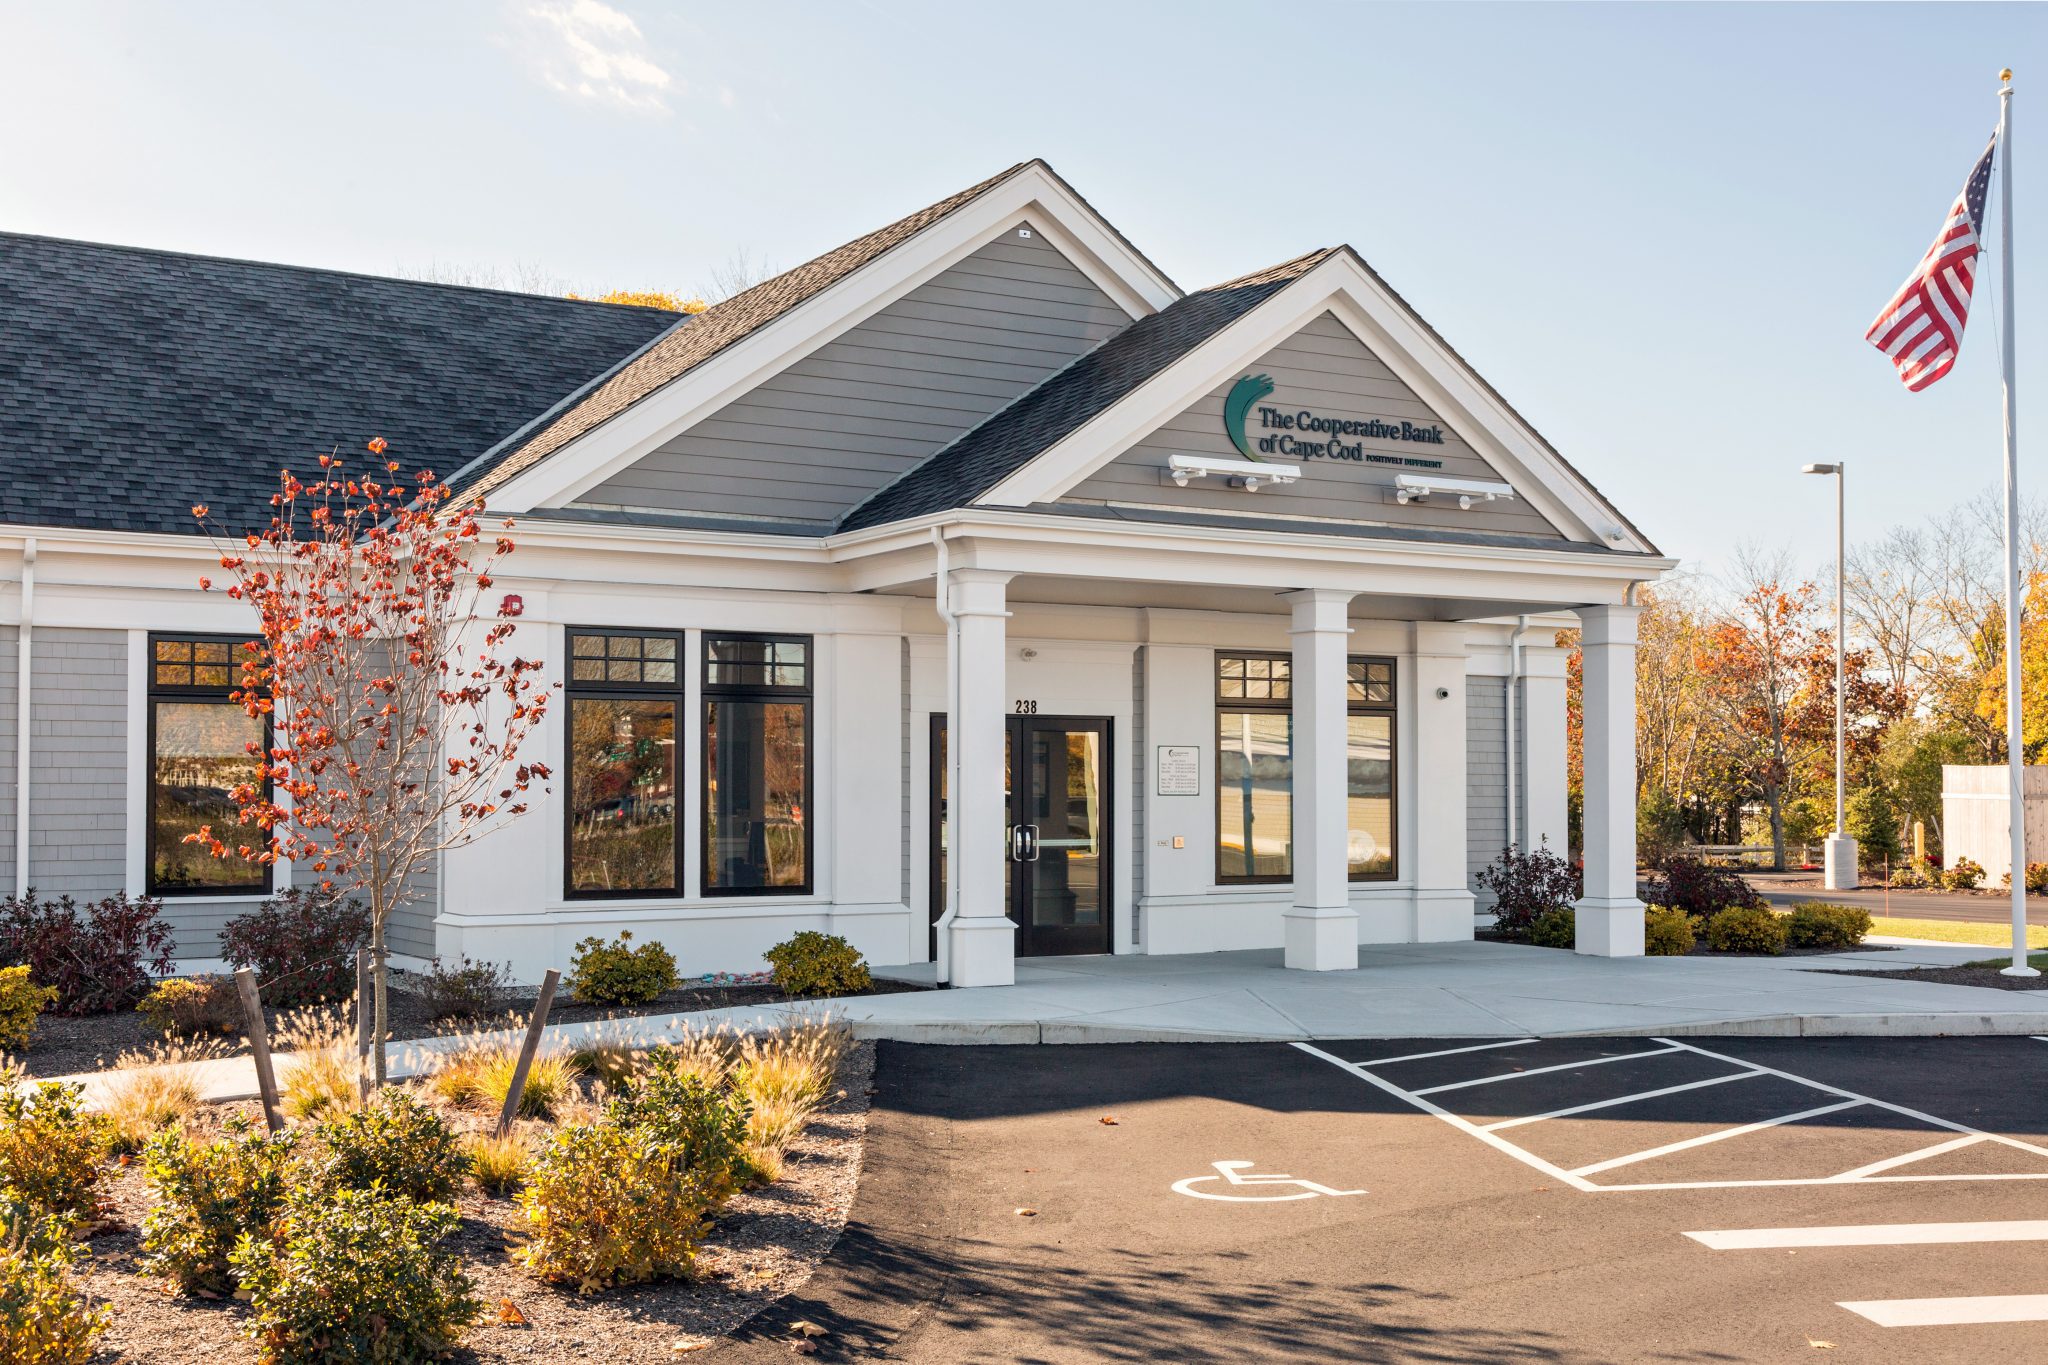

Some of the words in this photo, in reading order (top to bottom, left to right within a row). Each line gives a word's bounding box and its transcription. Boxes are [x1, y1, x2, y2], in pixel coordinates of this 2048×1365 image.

[1259, 407, 1294, 429] The
[1297, 411, 1400, 440] Cooperative
[1401, 421, 1445, 444] Bank
[1259, 433, 1278, 453] of
[1279, 435, 1325, 461] Cape
[1327, 439, 1363, 461] Cod
[1366, 454, 1403, 465] POSITIVELY
[1404, 458, 1443, 468] DIFFERENT
[1015, 699, 1037, 714] 238
